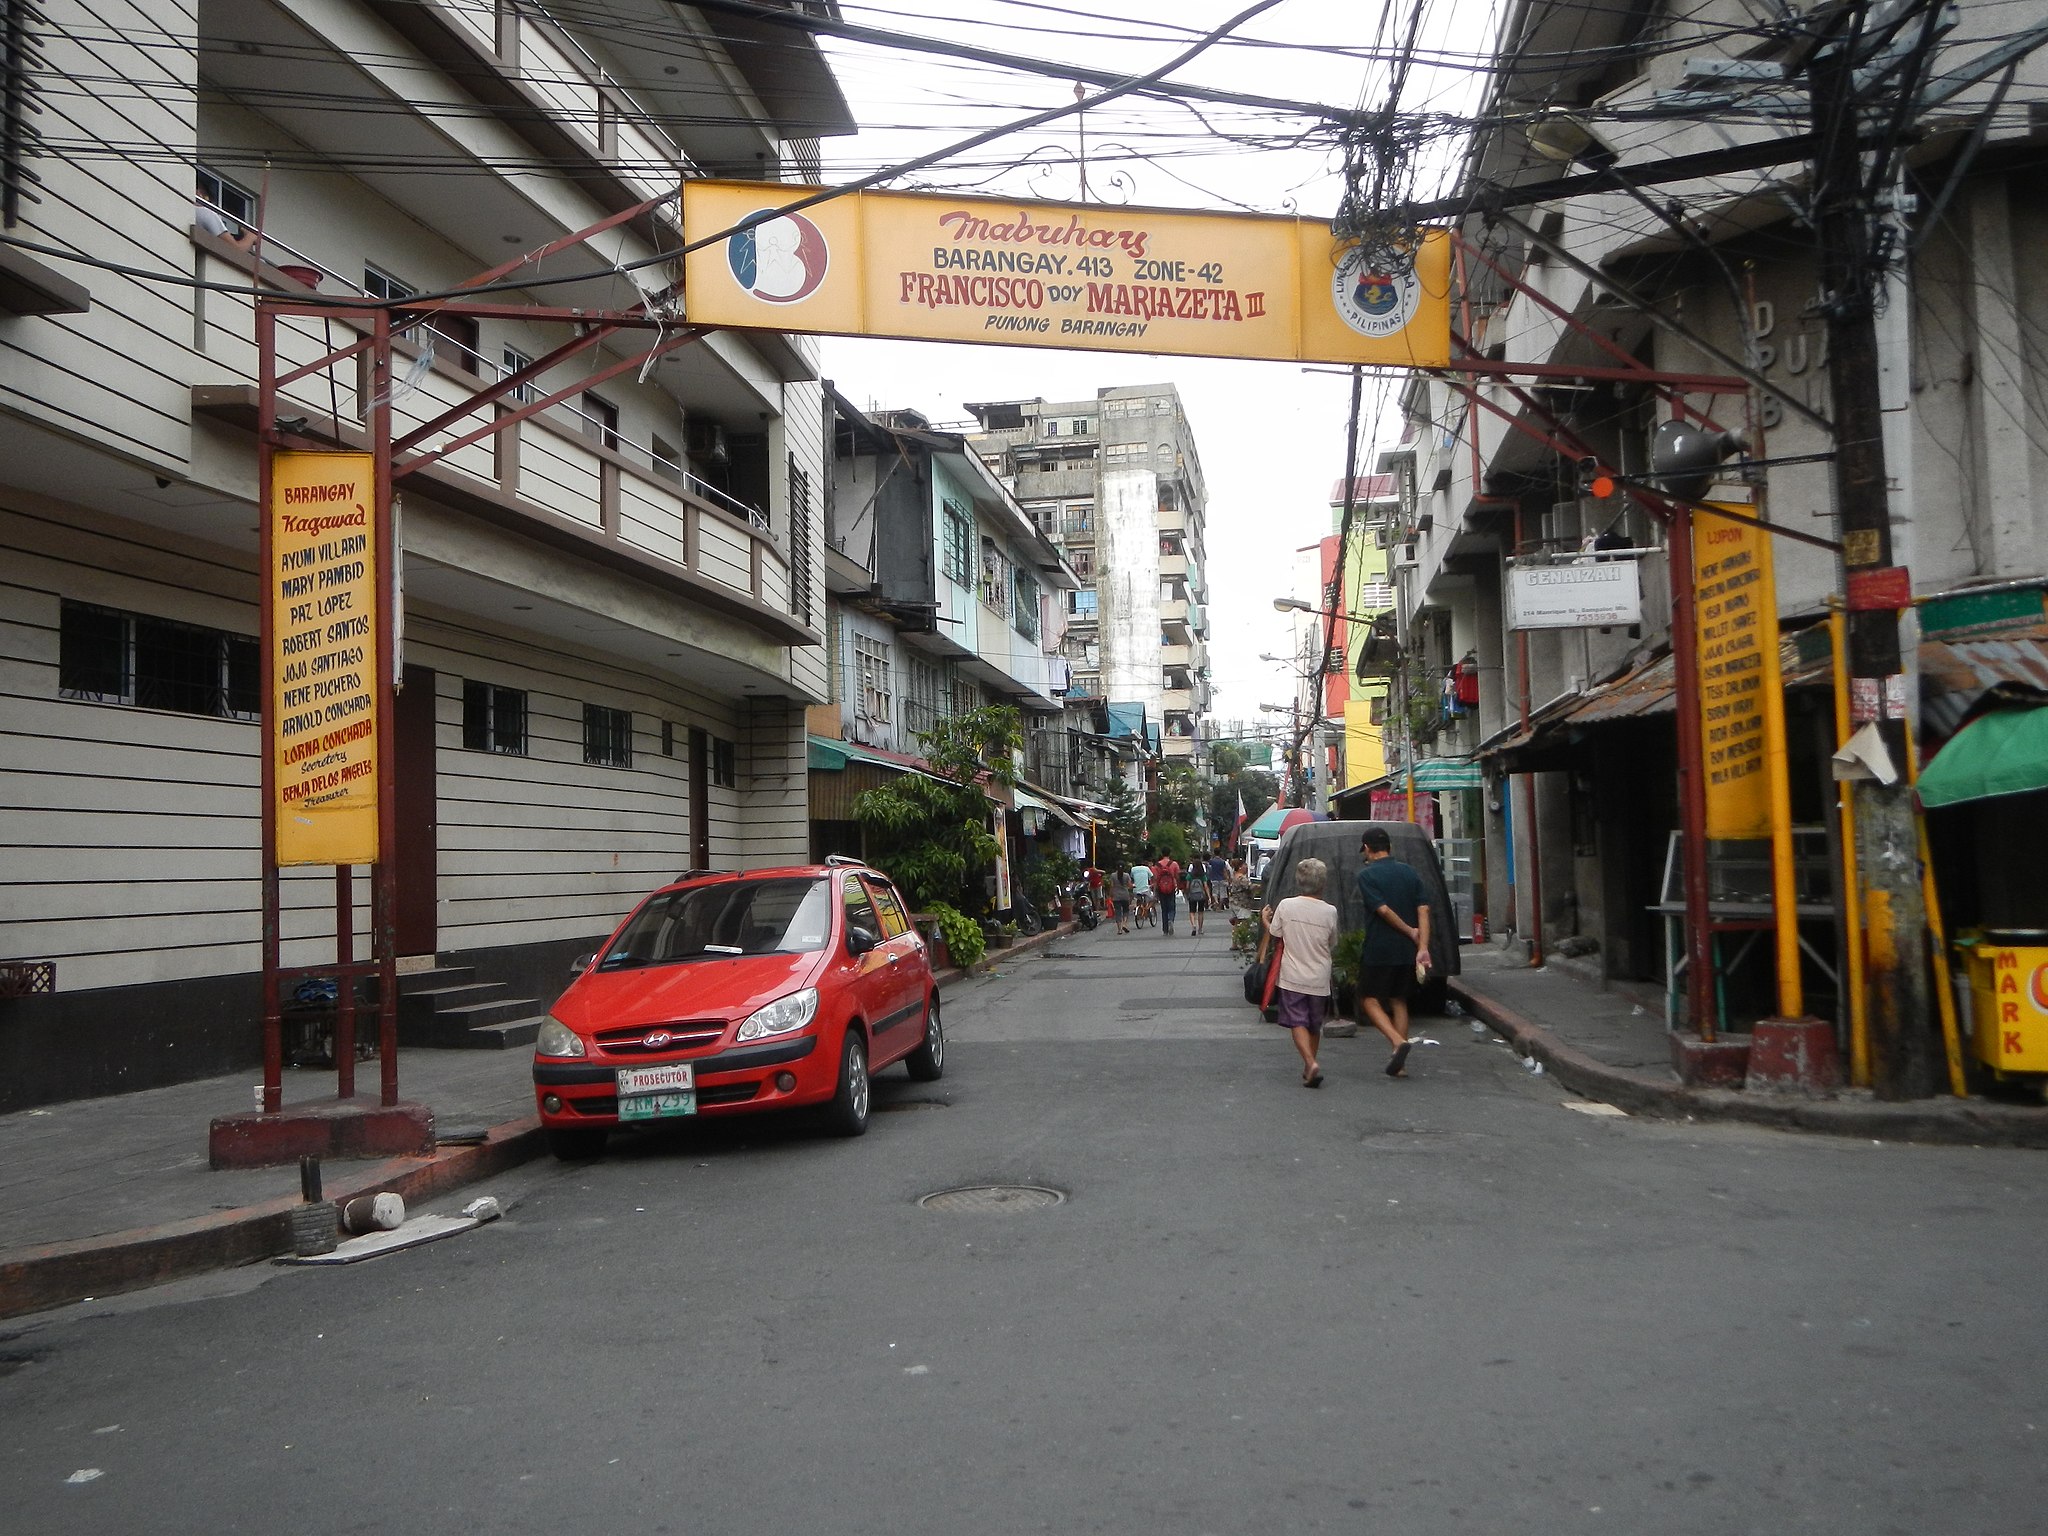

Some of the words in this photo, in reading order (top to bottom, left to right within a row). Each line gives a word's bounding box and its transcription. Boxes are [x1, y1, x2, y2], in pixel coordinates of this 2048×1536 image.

[900, 271, 1044, 309] FRANCISCO
[1087, 281, 1243, 321] MARIAZETA
[1245, 291, 1267, 318] III
[984, 315, 1051, 333] PUNONG
[1060, 318, 1148, 338] BARANGAY
[1350, 312, 1402, 332] PILIPINAS
[284, 482, 355, 504] BARANGAY
[281, 503, 367, 537] Kagawad
[1707, 528, 1742, 544] LUPON
[281, 546, 315, 572] AYUMI
[318, 534, 366, 562] VILLARIN
[281, 573, 315, 600] MARY
[318, 561, 365, 591] PAMBID
[1526, 567, 1620, 585] GENAIZAH
[290, 602, 313, 626] PAZ
[318, 591, 353, 617] LOPEZ
[282, 628, 322, 657] ROBERT
[326, 614, 369, 644] SANTOS
[282, 660, 307, 684] JOJO
[311, 646, 364, 676] SANTIAGO
[284, 685, 311, 710] NENE
[313, 672, 361, 701] PUCHERO
[282, 709, 323, 739] ARNOLD
[324, 694, 372, 723] CONCHADA
[284, 738, 320, 766] LORNA
[322, 718, 373, 752] CONCHADA
[282, 781, 310, 803] BENJA
[311, 770, 339, 794] DELOS
[341, 760, 373, 785] ANGELES
[1998, 951, 2024, 1054] MARK
[633, 1071, 688, 1087] PROSECUTOR
